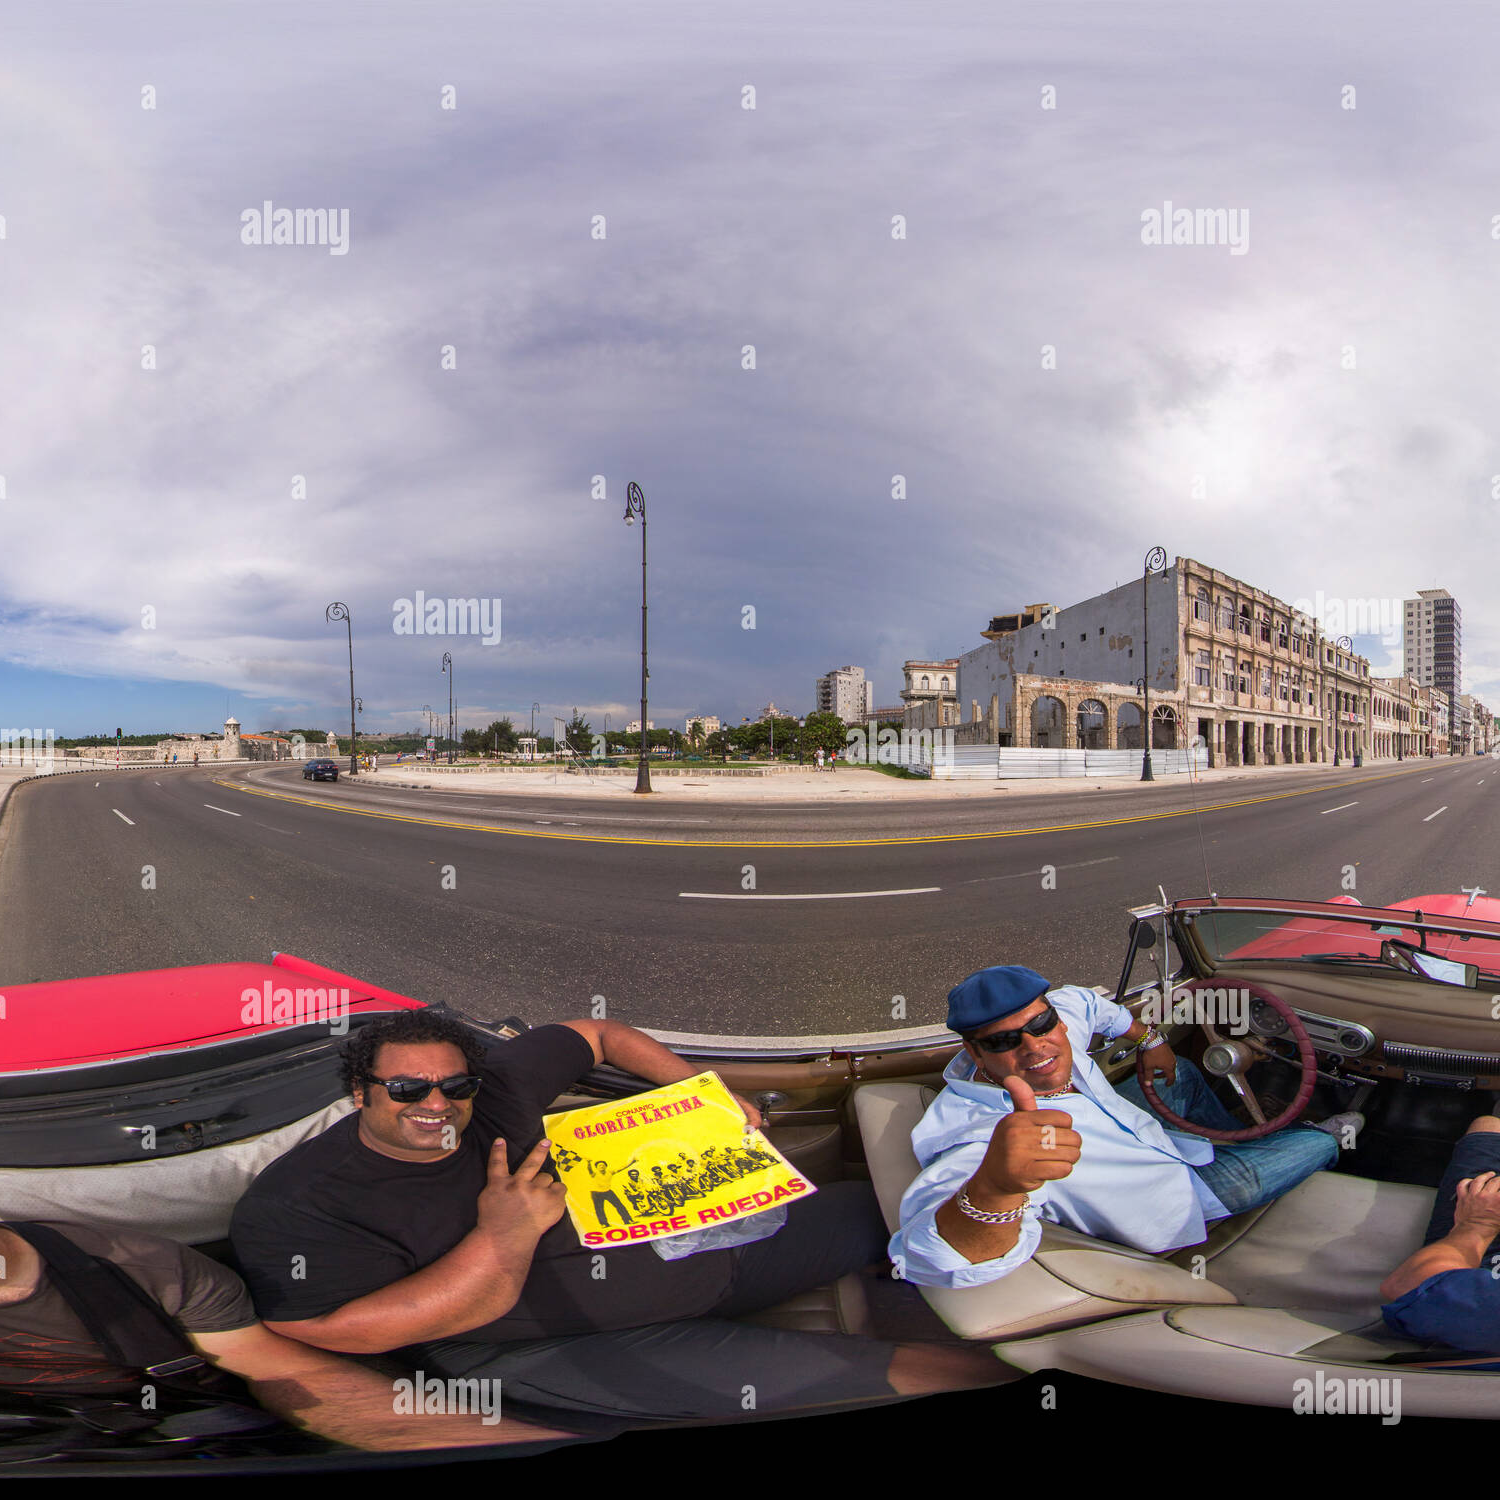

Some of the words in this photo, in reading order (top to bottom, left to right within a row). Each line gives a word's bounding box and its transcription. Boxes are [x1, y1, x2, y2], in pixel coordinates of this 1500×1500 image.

[574, 1115, 639, 1139] GLORIA
[640, 1096, 705, 1124] LATINA
[615, 1104, 654, 1117] CONJUNTO
[584, 1215, 690, 1245] SOBRE
[698, 1177, 807, 1223] RUEDAS
